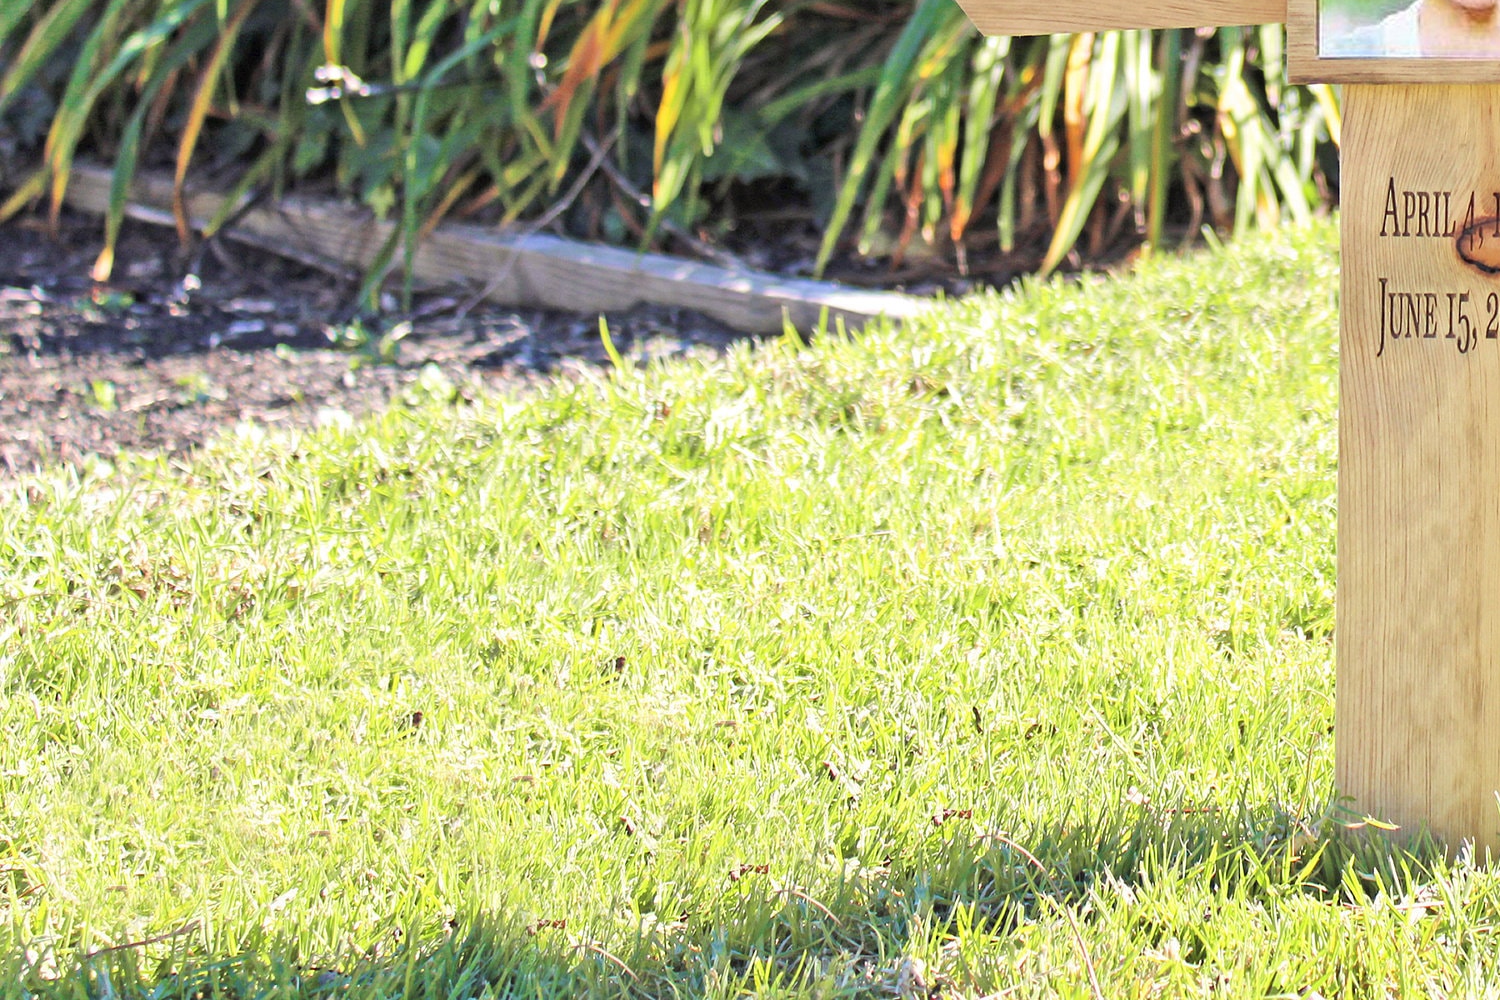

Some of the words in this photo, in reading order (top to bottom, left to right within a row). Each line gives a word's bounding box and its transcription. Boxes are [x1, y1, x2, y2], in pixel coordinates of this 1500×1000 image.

[1379, 176, 1457, 238] APRIL
[1459, 190, 1484, 252] 4,
[1376, 277, 1438, 358] JUNE
[1444, 289, 1478, 355] 15,
